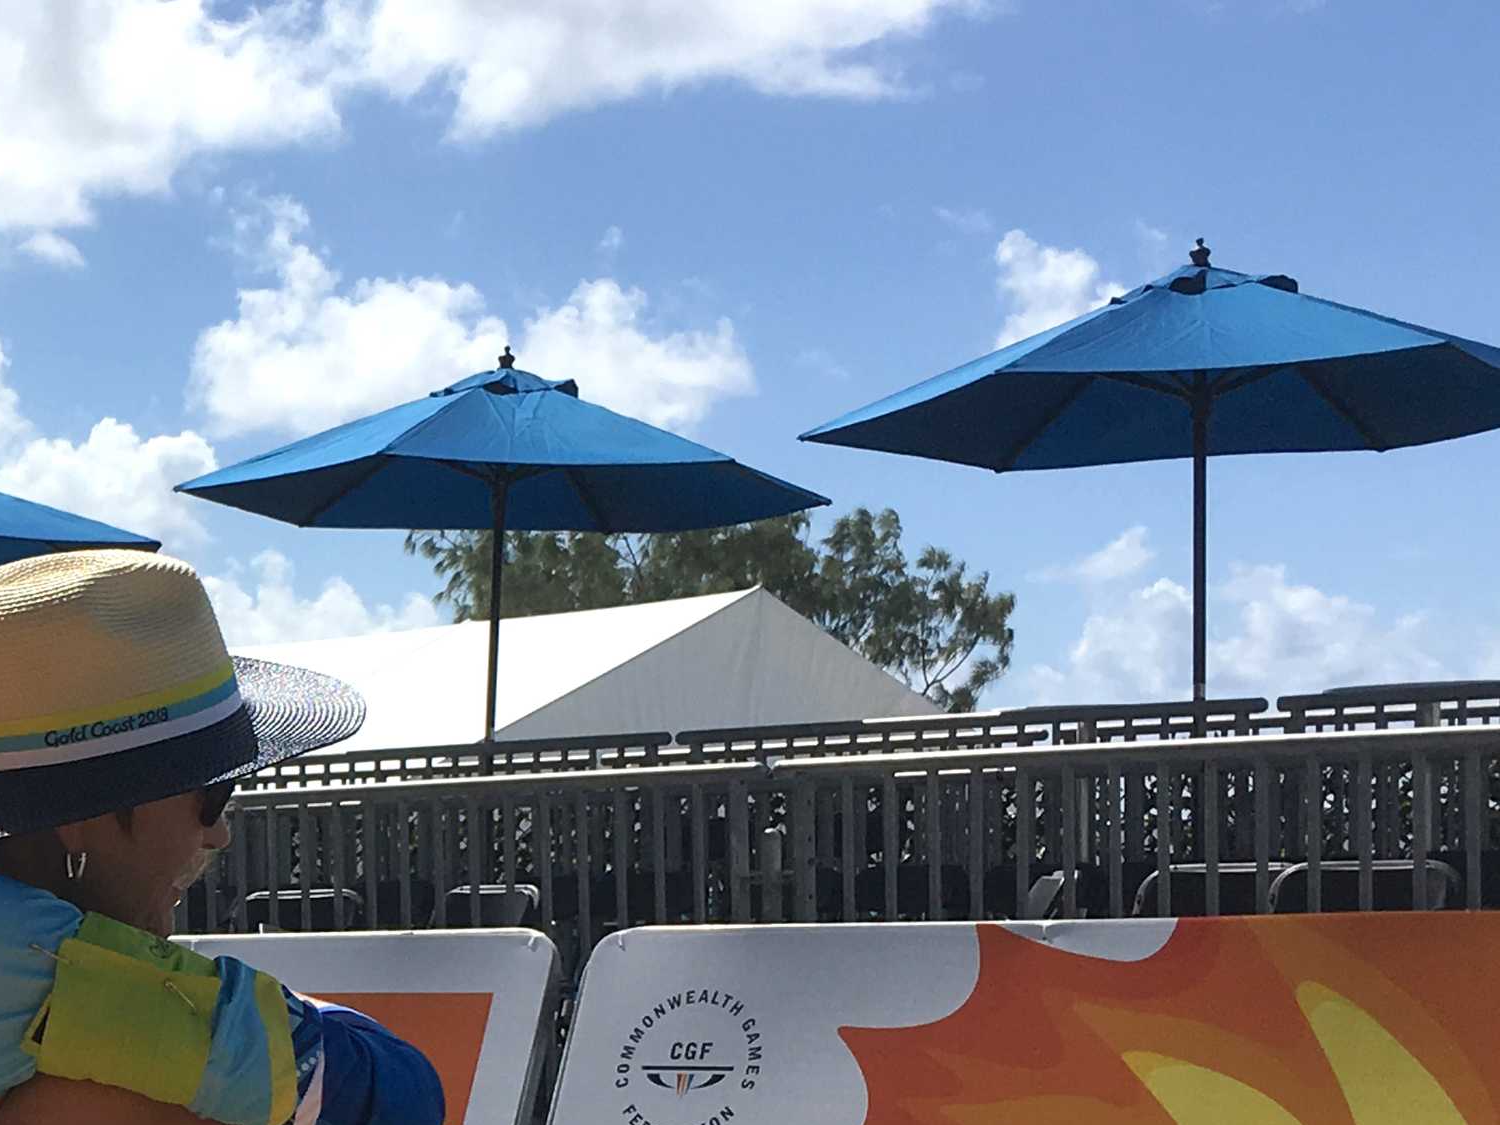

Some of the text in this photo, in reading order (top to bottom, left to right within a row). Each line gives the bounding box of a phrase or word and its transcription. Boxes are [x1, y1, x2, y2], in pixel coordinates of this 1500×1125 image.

[44, 726, 86, 748] Gold
[90, 716, 135, 740] Coast
[615, 989, 763, 1091] COMMONWEALTH GAMES
[669, 1041, 714, 1061] CGF
